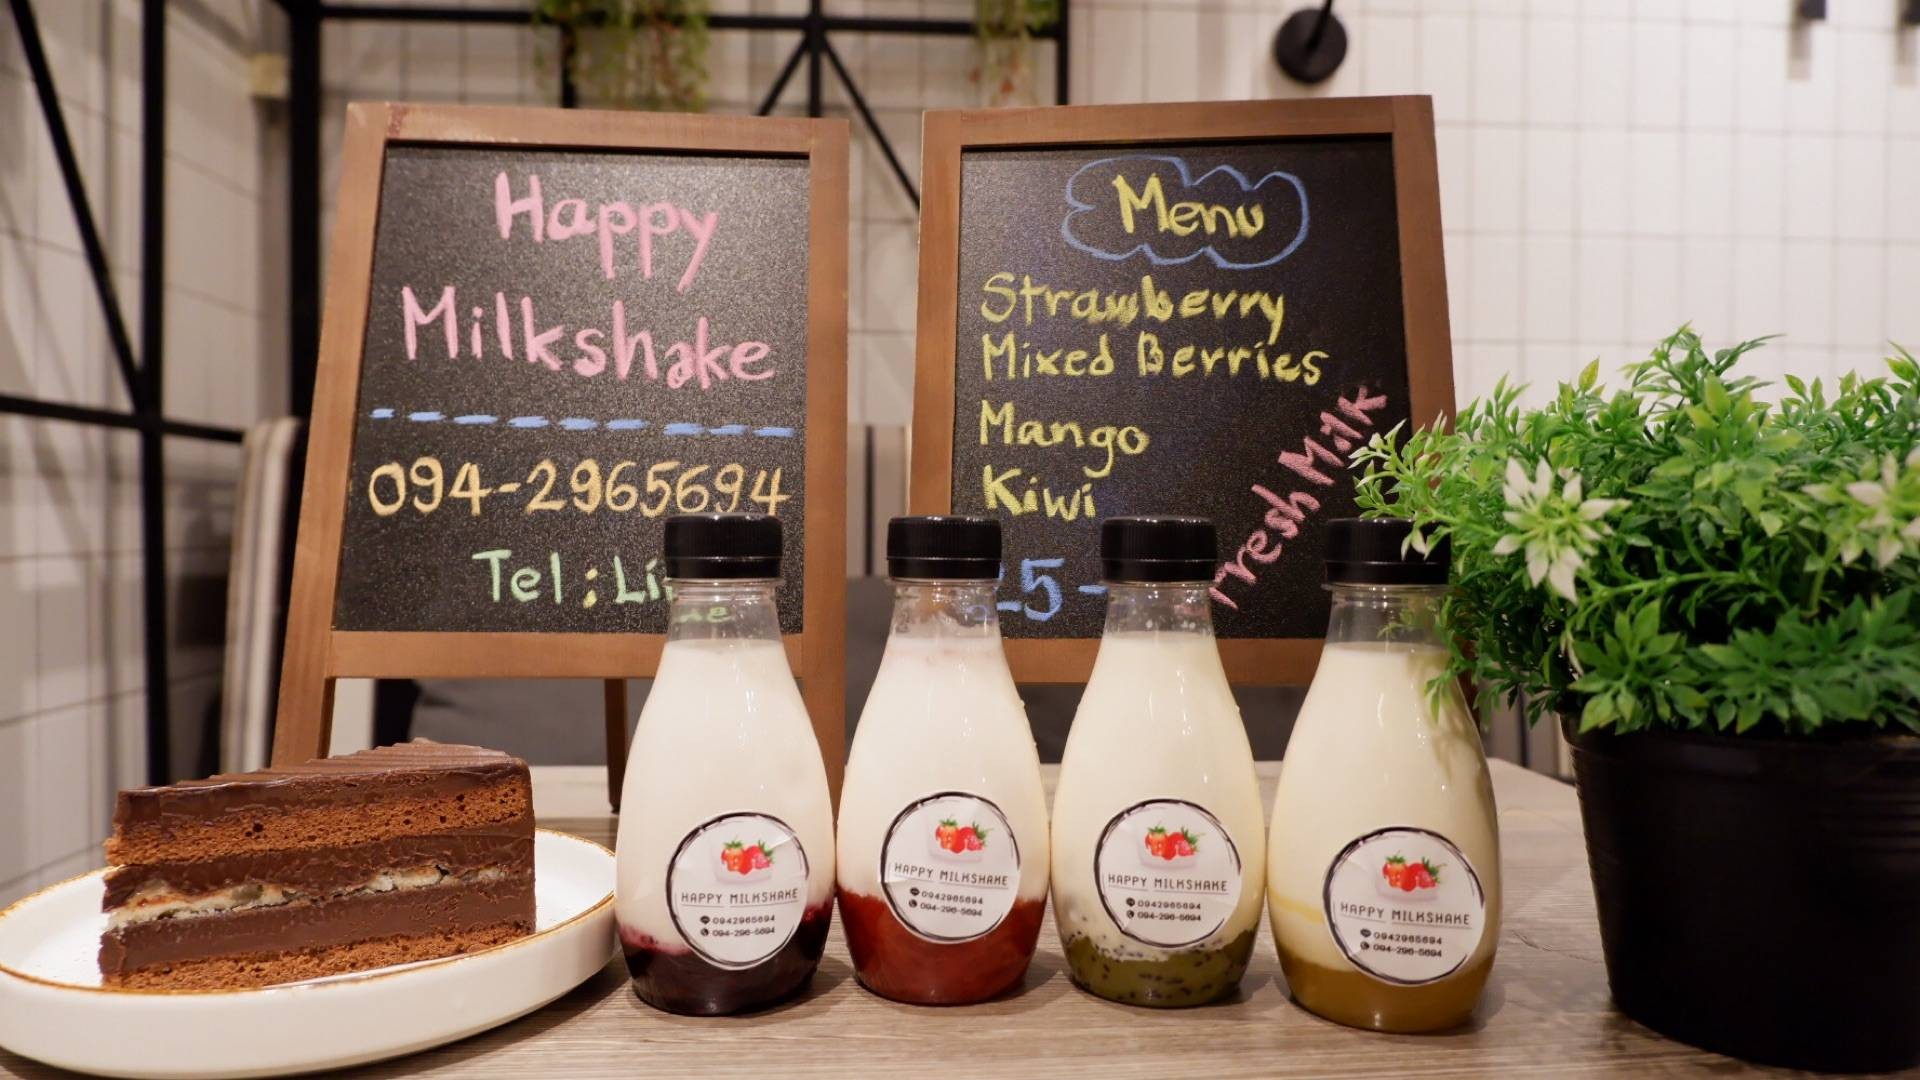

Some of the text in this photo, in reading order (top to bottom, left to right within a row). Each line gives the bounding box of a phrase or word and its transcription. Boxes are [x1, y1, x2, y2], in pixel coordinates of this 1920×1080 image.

[494, 171, 718, 293] Happy
[1112, 172, 1266, 239] Menu
[402, 285, 775, 389] Milkshake
[980, 271, 1285, 345] Strawberry
[981, 330, 1330, 386] Mixed Berries
[978, 399, 1151, 478] Mango
[1277, 385, 1388, 487] Milk
[368, 456, 791, 517] 094-2965694
[982, 464, 1097, 521] Kiwi
[681, 887, 799, 904] HAPPY MILKSHAKE
[894, 862, 1009, 887] HAPPY MILKSHAKE
[1108, 873, 1228, 892] HAPPY MILKSHAKE
[1340, 902, 1471, 926] HAPPY MILKSHAKE
